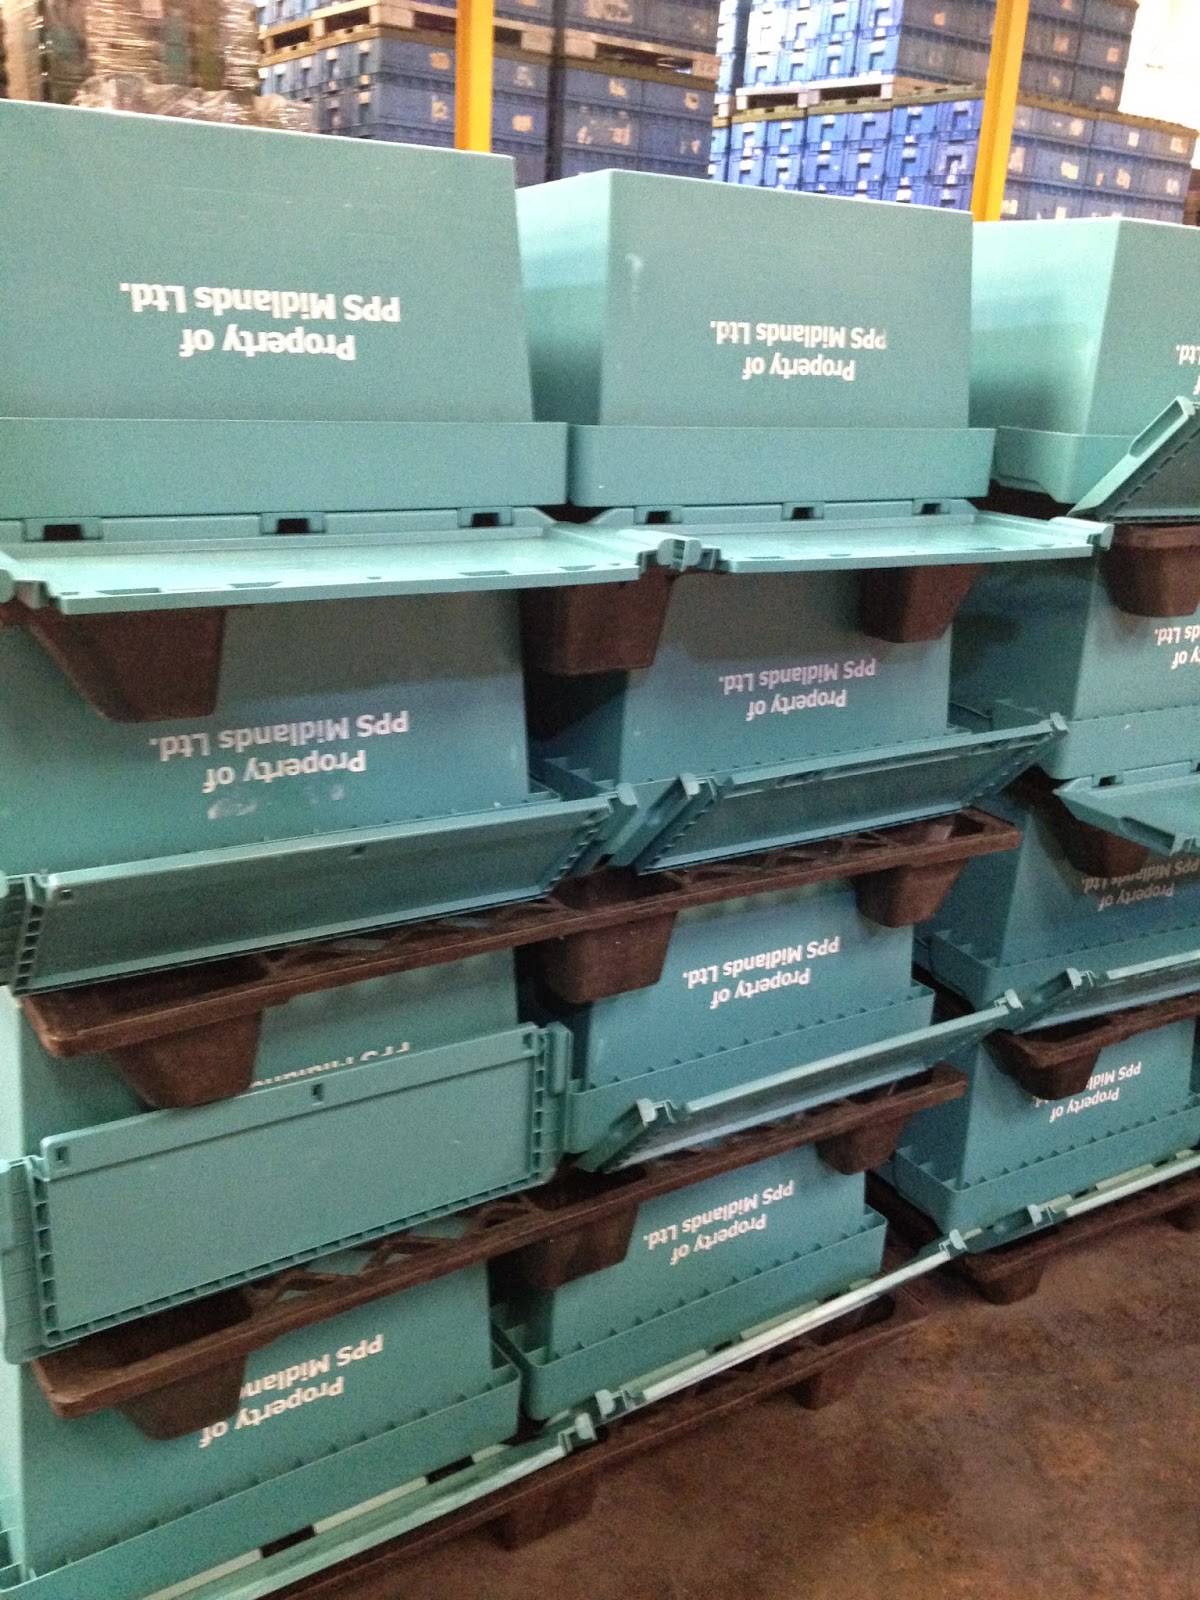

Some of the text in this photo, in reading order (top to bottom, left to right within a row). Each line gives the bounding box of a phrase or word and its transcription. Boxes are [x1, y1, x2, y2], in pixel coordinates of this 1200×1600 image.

[120, 283, 400, 322] PPS Midlands Ltd.
[179, 324, 356, 361] Property of
[710, 321, 887, 349] PPS Midlands Ltd.
[742, 352, 856, 381] Property of
[1154, 626, 1181, 646] Ltd.
[719, 658, 877, 695] PPS Midlands Ltd.
[1170, 650, 1188, 670] of
[746, 688, 848, 721] Property of
[149, 710, 409, 761] PPS Midlands Ltd.
[201, 750, 367, 793] Property of
[1097, 882, 1175, 912] Property of
[682, 935, 841, 989] PPS Midlands Ltd.
[709, 967, 811, 1010] Property of
[1086, 1060, 1142, 1091] PPS Midl
[1048, 1105, 1064, 1123] of
[1066, 1087, 1120, 1114] Property
[643, 1179, 795, 1250] PPS Midlands Ltd.
[670, 1213, 767, 1266] Property of
[239, 1334, 384, 1399] PPS Midlan
[199, 1376, 345, 1449] Property of
